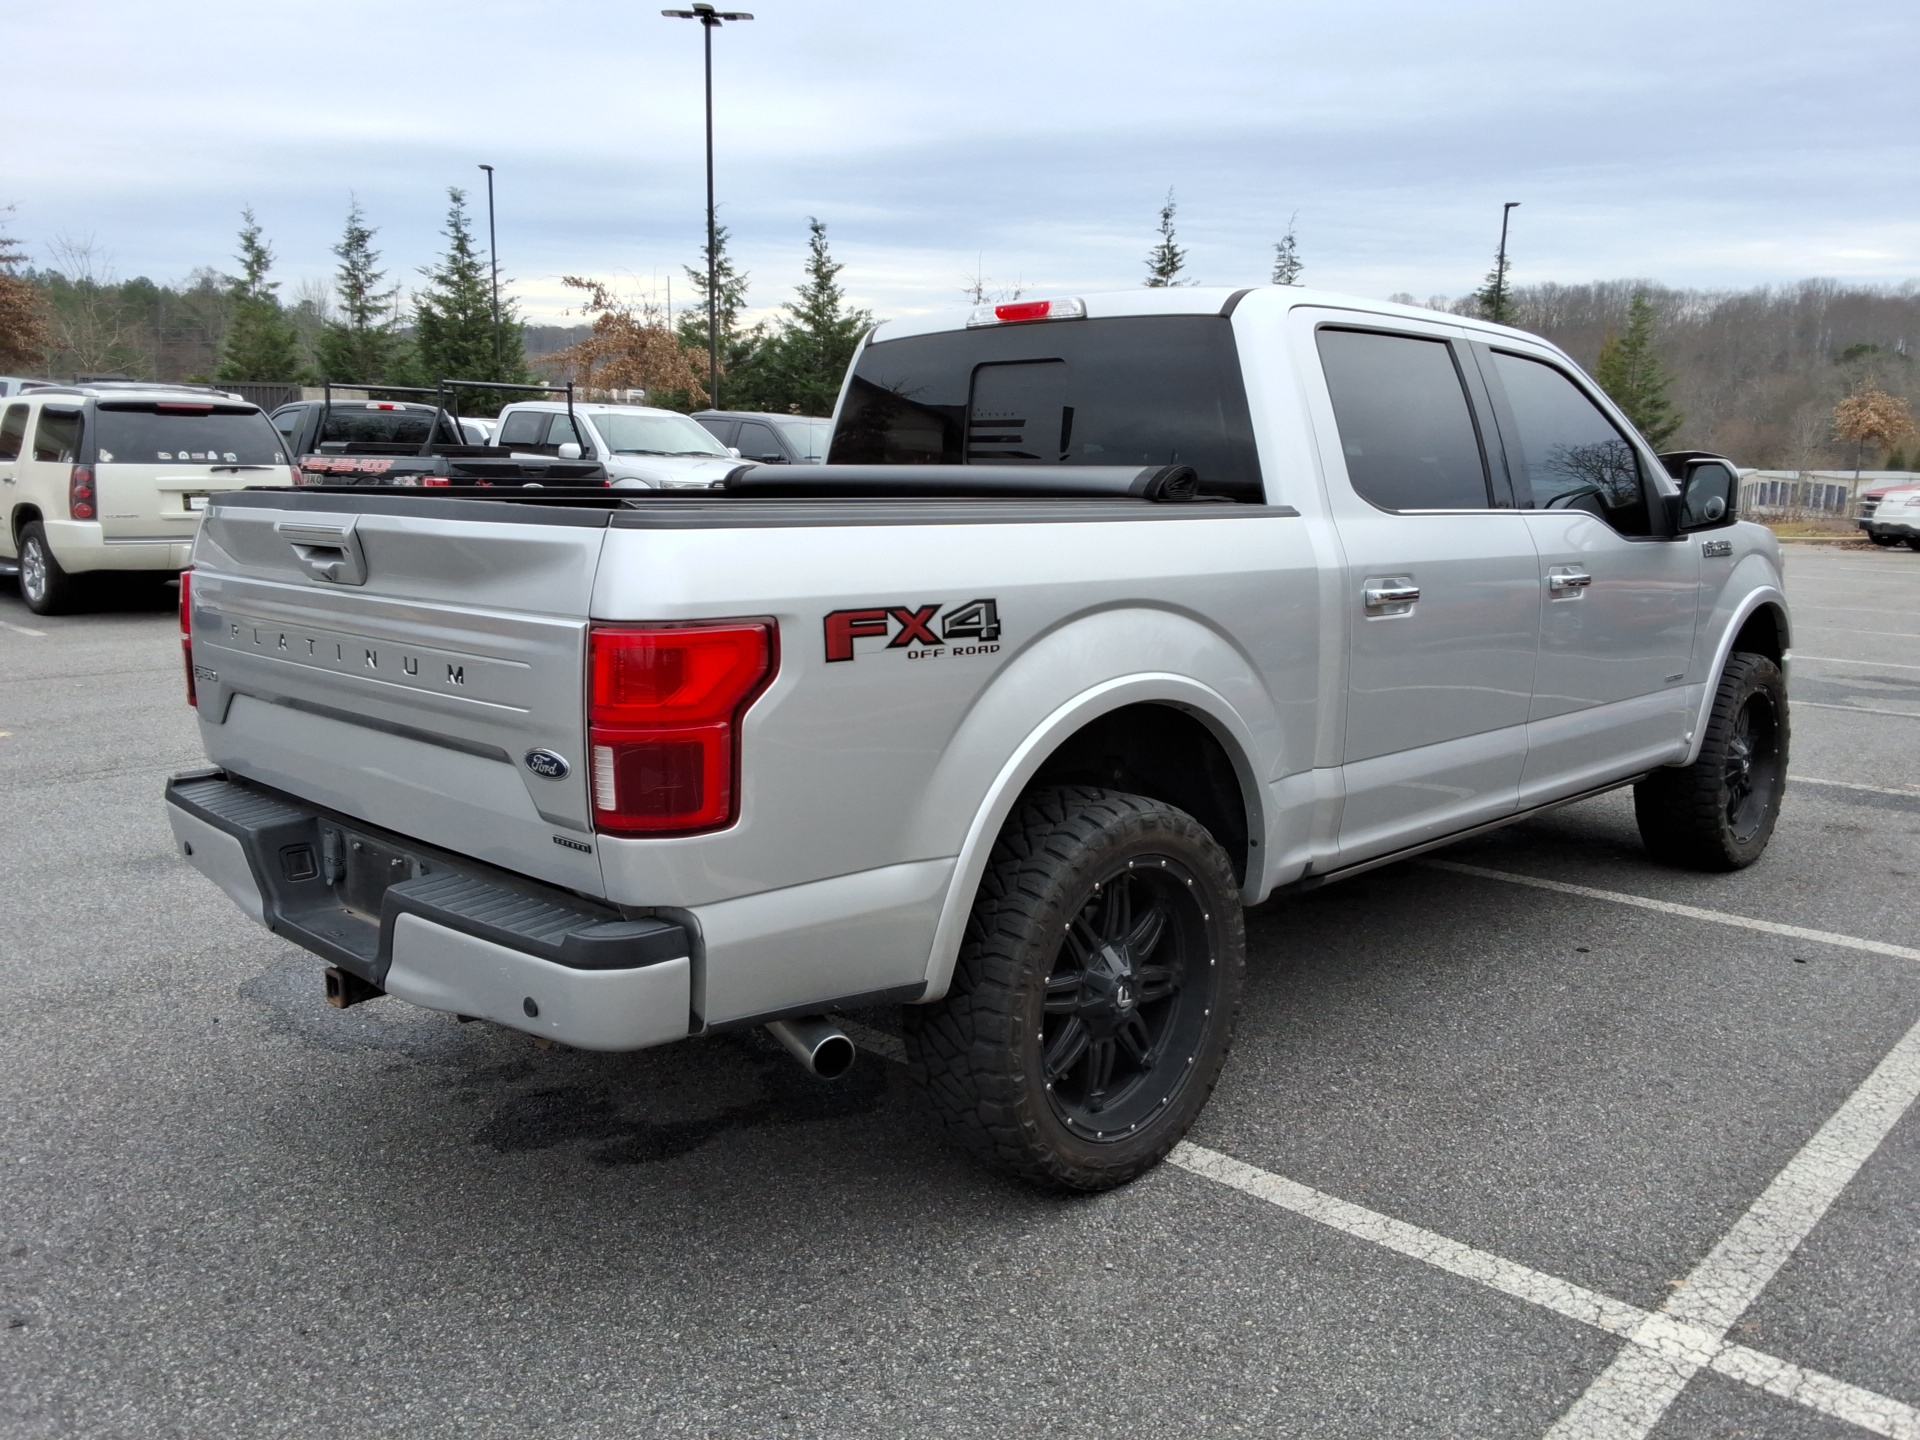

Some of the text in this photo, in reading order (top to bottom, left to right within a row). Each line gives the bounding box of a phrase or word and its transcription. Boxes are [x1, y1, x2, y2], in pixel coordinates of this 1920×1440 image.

[823, 598, 1001, 663] FX4
[231, 624, 466, 686] PLATINUM
[908, 644, 1001, 660] OFF ROAD
[531, 754, 558, 776] Ford
